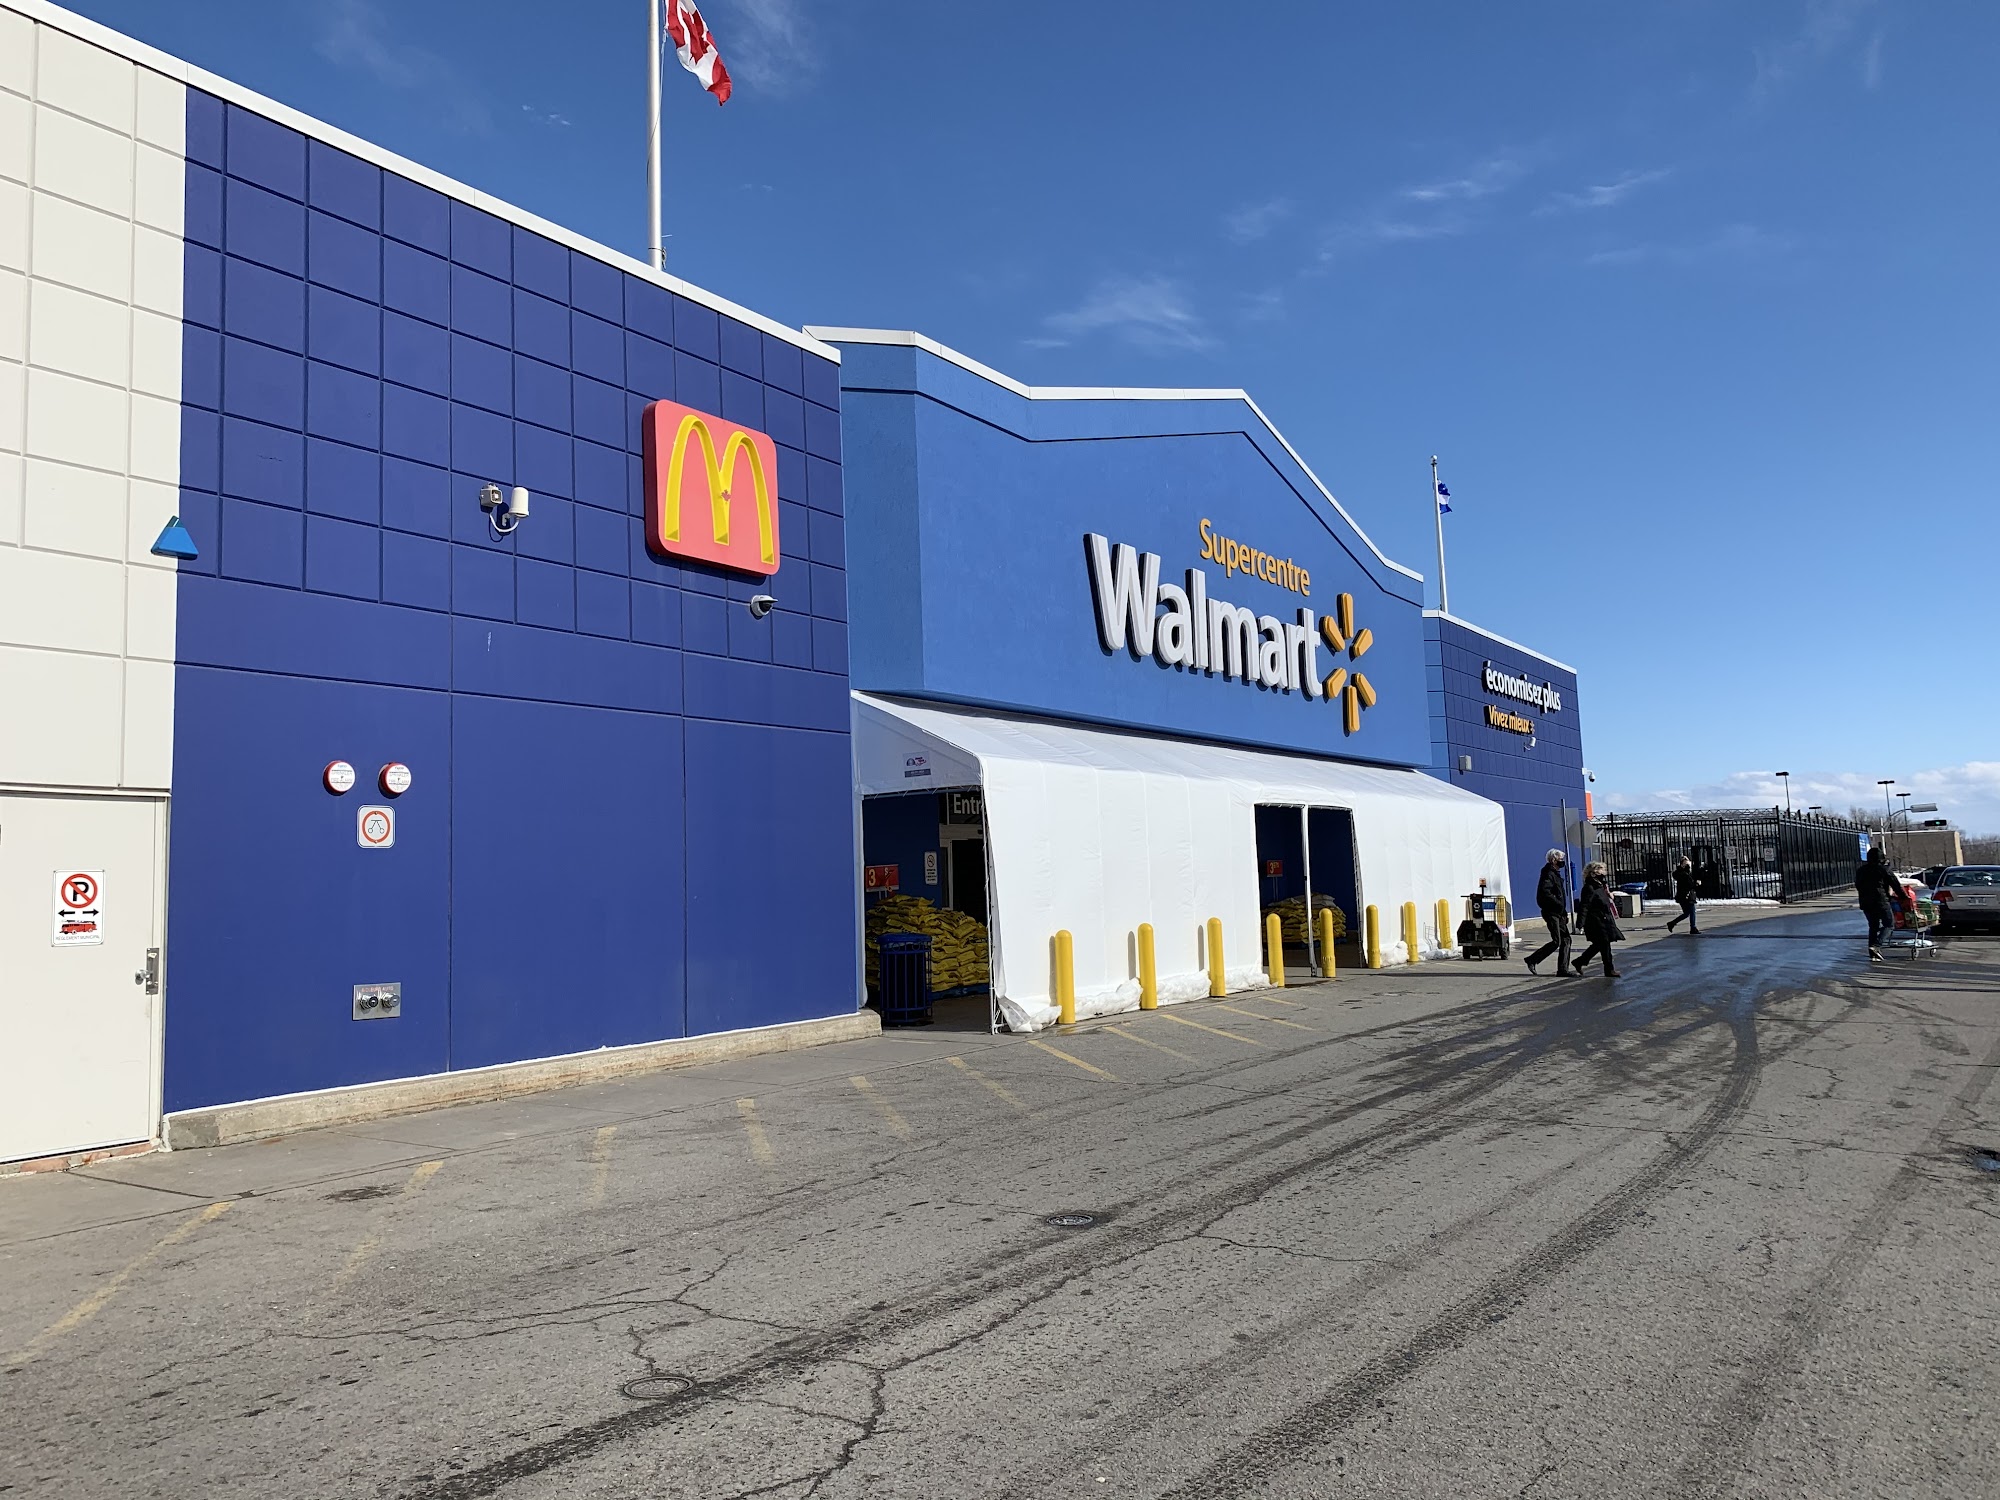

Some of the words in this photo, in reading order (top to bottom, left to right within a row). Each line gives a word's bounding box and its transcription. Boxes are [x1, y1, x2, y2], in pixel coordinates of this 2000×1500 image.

[1199, 518, 1311, 596] Supercentre
[1085, 533, 1323, 698] Walmart
[1485, 660, 1543, 706] économisez
[1543, 682, 1561, 714] plus
[1488, 705, 1508, 728] Vivez
[1509, 711, 1530, 733] mieux
